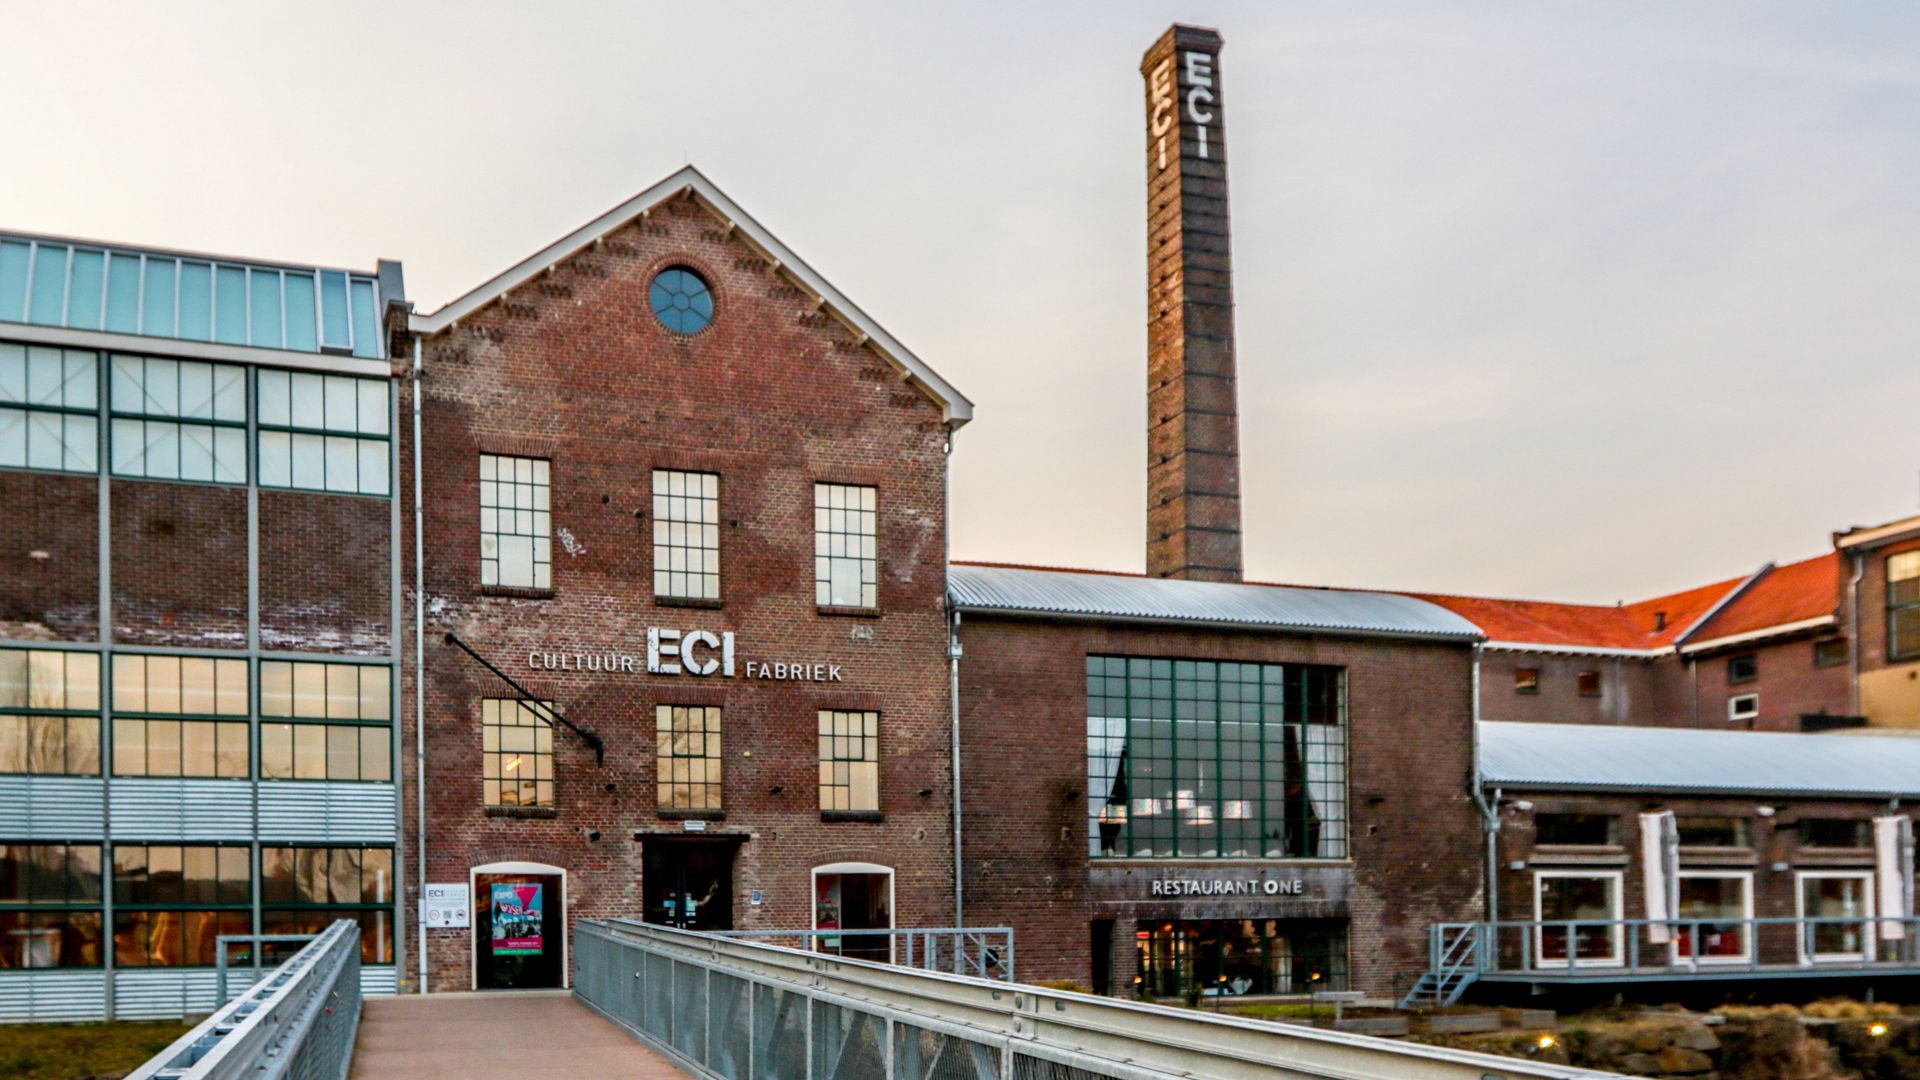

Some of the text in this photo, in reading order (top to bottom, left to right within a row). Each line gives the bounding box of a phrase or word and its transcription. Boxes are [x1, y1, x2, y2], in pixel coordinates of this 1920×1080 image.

[1152, 58, 1172, 170] ECI
[1186, 51, 1213, 159] ECI
[528, 626, 842, 682] CULTUUR ECI FABRIEK
[428, 889, 444, 898] ECI
[1152, 879, 1303, 895] RESTAURANT ONE
